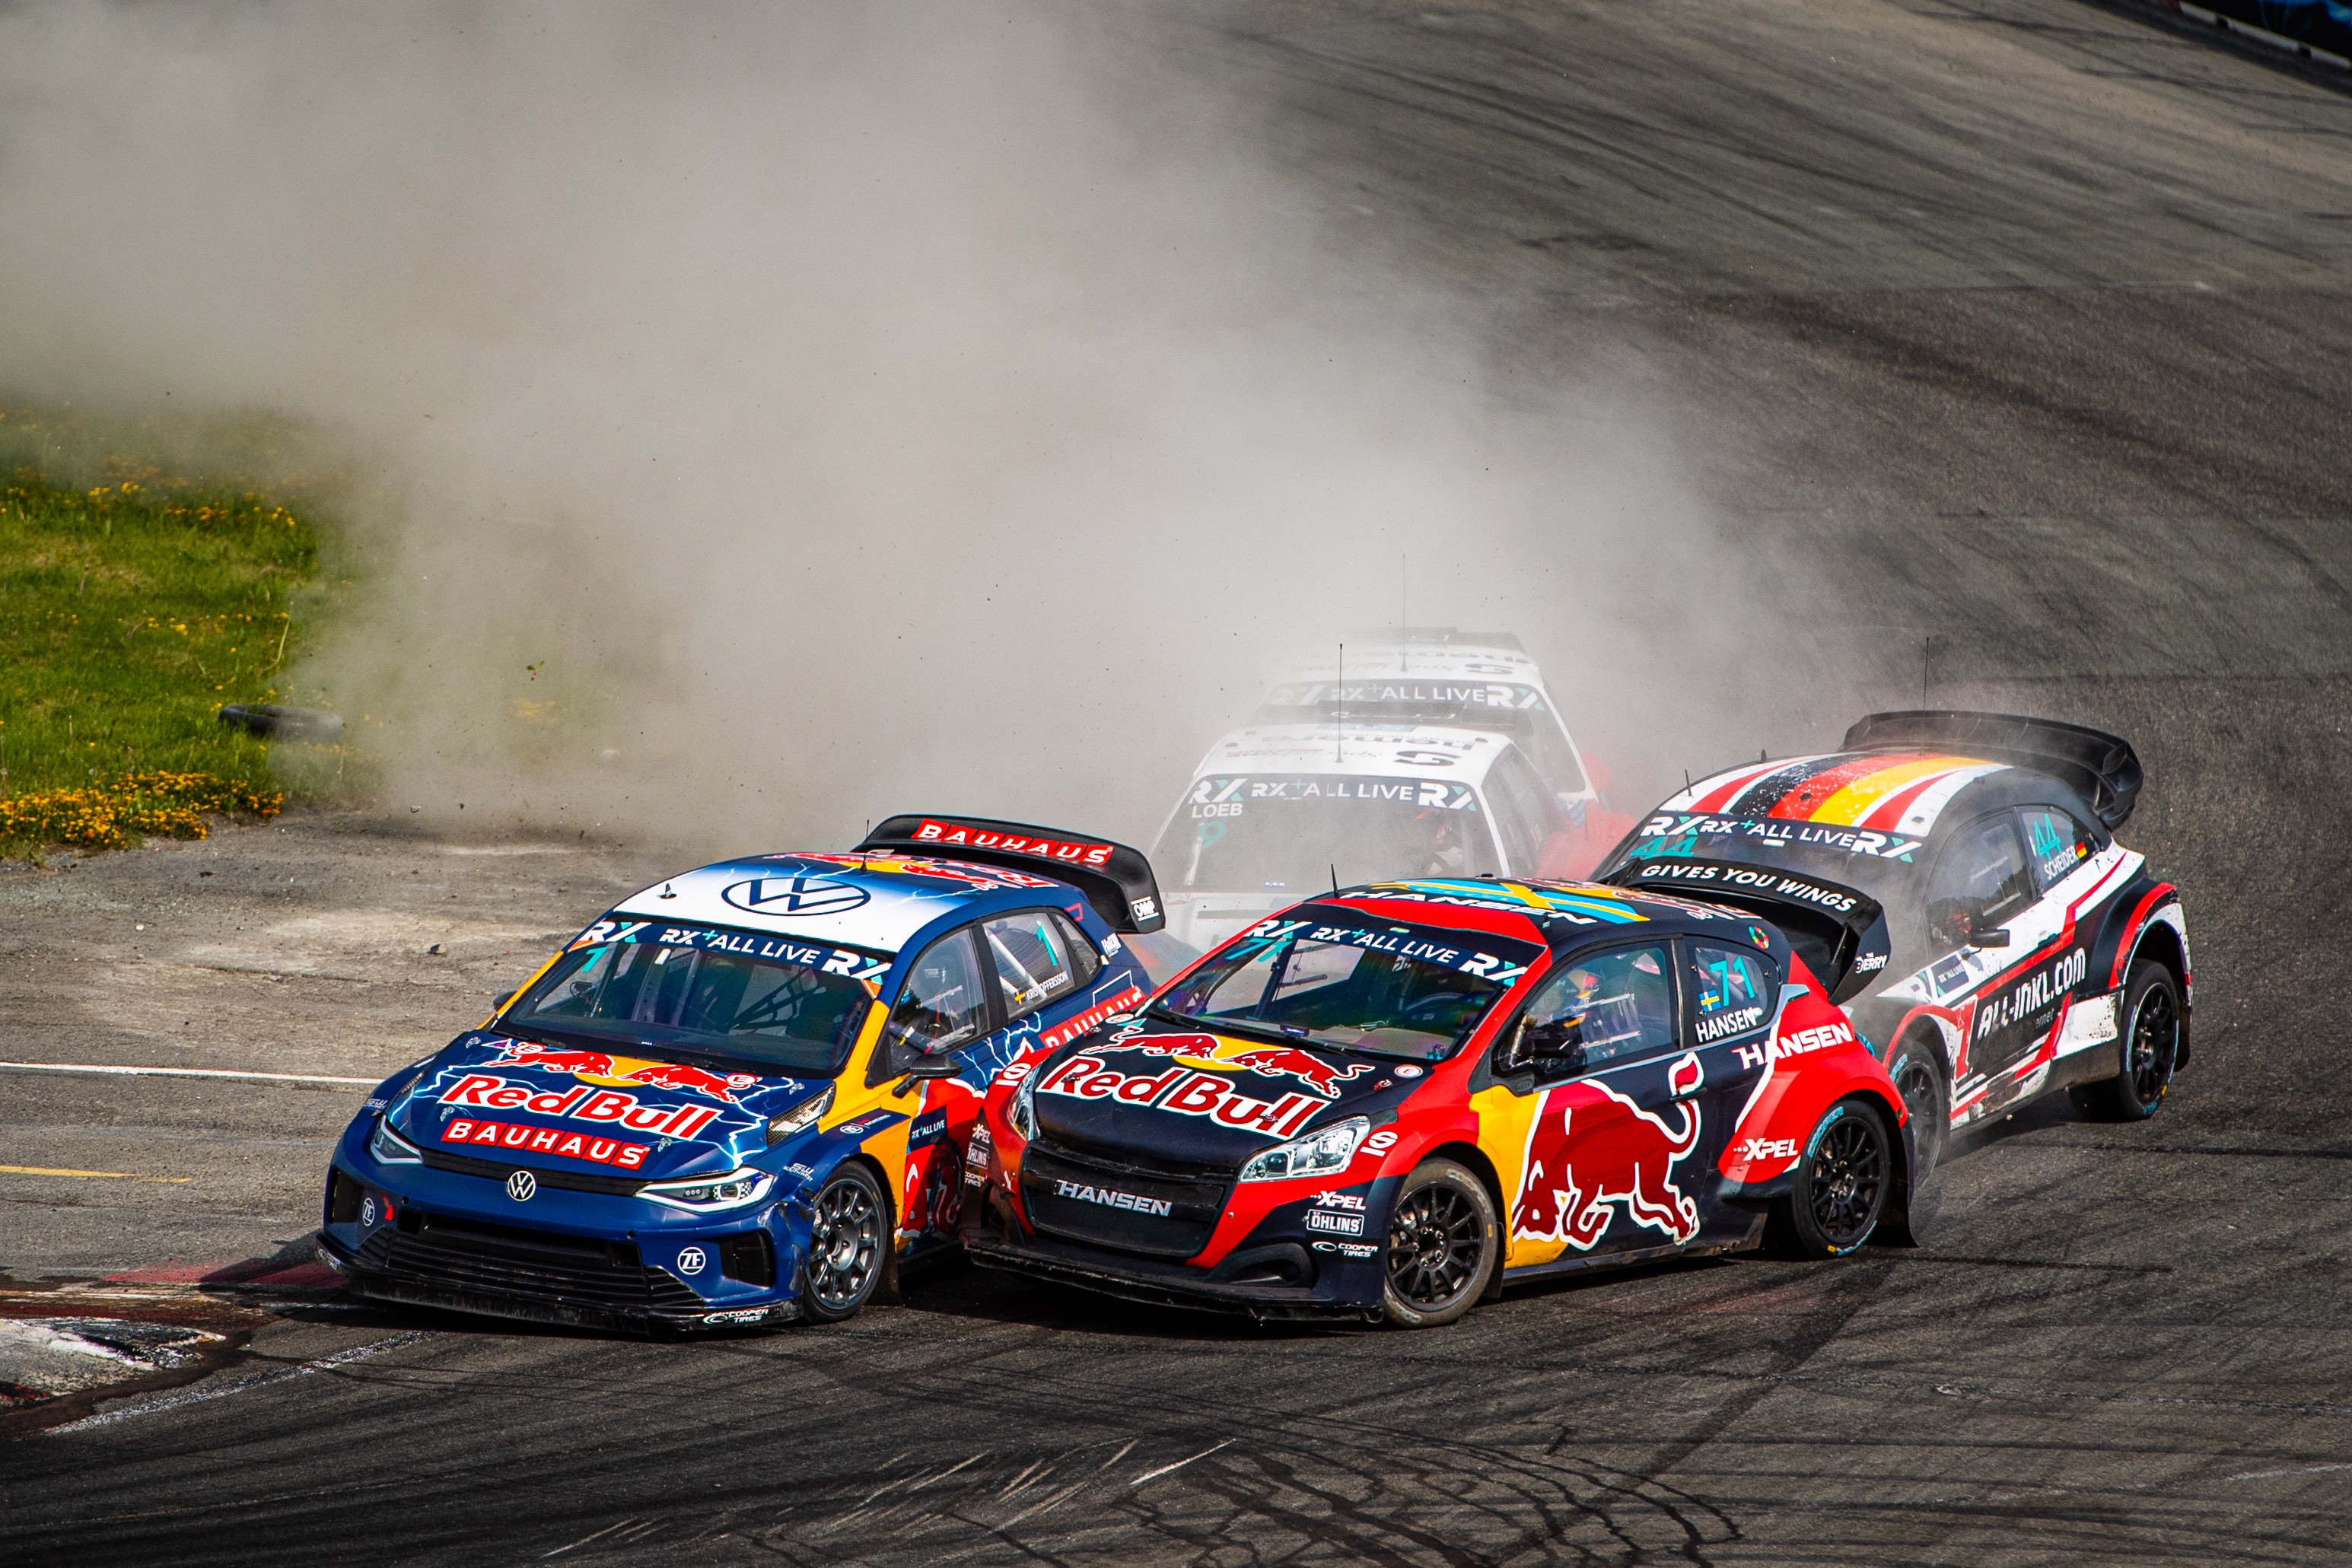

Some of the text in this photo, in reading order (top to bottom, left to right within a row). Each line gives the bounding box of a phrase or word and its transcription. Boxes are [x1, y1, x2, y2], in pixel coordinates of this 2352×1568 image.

[1433, 686, 1485, 702] LIVE
[1486, 685, 1545, 711] RX
[1188, 778, 1248, 804] RX
[1357, 782, 1414, 801] LIVE
[1418, 781, 1478, 813] RX
[1191, 803, 1244, 819] LOEB
[916, 824, 1110, 865] BAUHAUS
[1629, 835, 1698, 860] 44
[1640, 816, 1704, 838] RX
[1799, 827, 1854, 848] LIVE
[1851, 832, 1923, 864] RX
[2034, 813, 2062, 861] 44
[2044, 844, 2079, 880] SCHEIDER
[1641, 864, 1720, 880] GIVES
[1722, 868, 1778, 888] YOU
[1775, 879, 1857, 911] WINGS
[1132, 898, 1157, 918] OMP
[1338, 891, 1597, 924] HANSEN
[581, 921, 652, 943] RX
[760, 941, 821, 964] LIVE
[821, 949, 893, 986] RX
[1036, 921, 1058, 967] 1
[1226, 937, 1293, 962] 71
[1244, 920, 1313, 939] RX
[1400, 940, 1459, 964] LIVE
[1459, 953, 1529, 988] RX
[1709, 956, 1755, 1007] 71
[1855, 954, 1888, 974] BERRY
[1026, 971, 1068, 1000] KRISOFFERSSON
[1695, 1006, 1758, 1043] HANSEN
[1732, 1021, 1854, 1070] HANSEN
[438, 1073, 724, 1141] Red Bull
[1036, 1054, 1332, 1141] Red Bull
[934, 1119, 945, 1132] LIVE
[1807, 1106, 1844, 1158] COOPER
[447, 1121, 649, 1168] BAUHAUS
[1743, 1137, 1800, 1162] XPEL
[363, 1201, 374, 1223] ZF
[1055, 1180, 1173, 1217] HANSEN
[1316, 1190, 1366, 1210] XPEL
[1310, 1210, 1361, 1233] ÖHLINS
[678, 1250, 704, 1271] ZF
[1338, 1242, 1379, 1253] COOPER
[728, 1309, 769, 1318] COOPER
